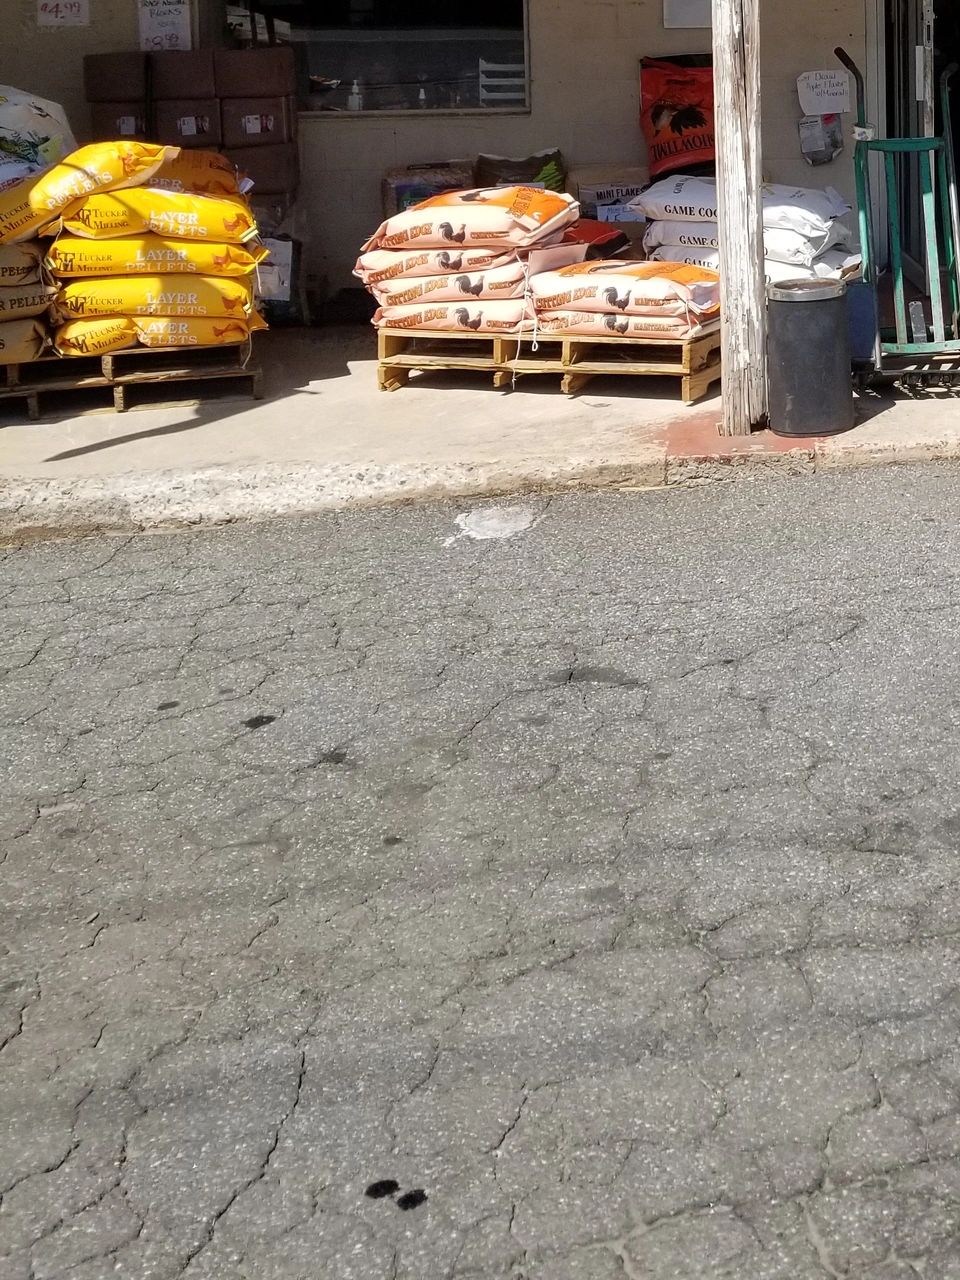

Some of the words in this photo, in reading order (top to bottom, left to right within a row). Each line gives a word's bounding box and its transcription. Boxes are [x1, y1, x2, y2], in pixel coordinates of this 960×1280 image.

[596, 189, 614, 201] MINI
[92, 208, 128, 218] TUCKER
[150, 210, 199, 224] LAYER
[664, 204, 695, 216] GAME
[698, 207, 718, 218] COC
[93, 221, 129, 230] MILLING
[679, 235, 707, 247] GAME
[77, 252, 113, 262] TUCKER
[136, 249, 187, 261] LAYER
[126, 262, 197, 272] PELLETS
[684, 257, 712, 269] GAME
[87, 296, 124, 306] TUCKER
[147, 292, 198, 305] LAYER
[136, 305, 207, 315] PELLETS
[86, 323, 123, 340] TUCKER
[91, 334, 127, 351] MILLING
